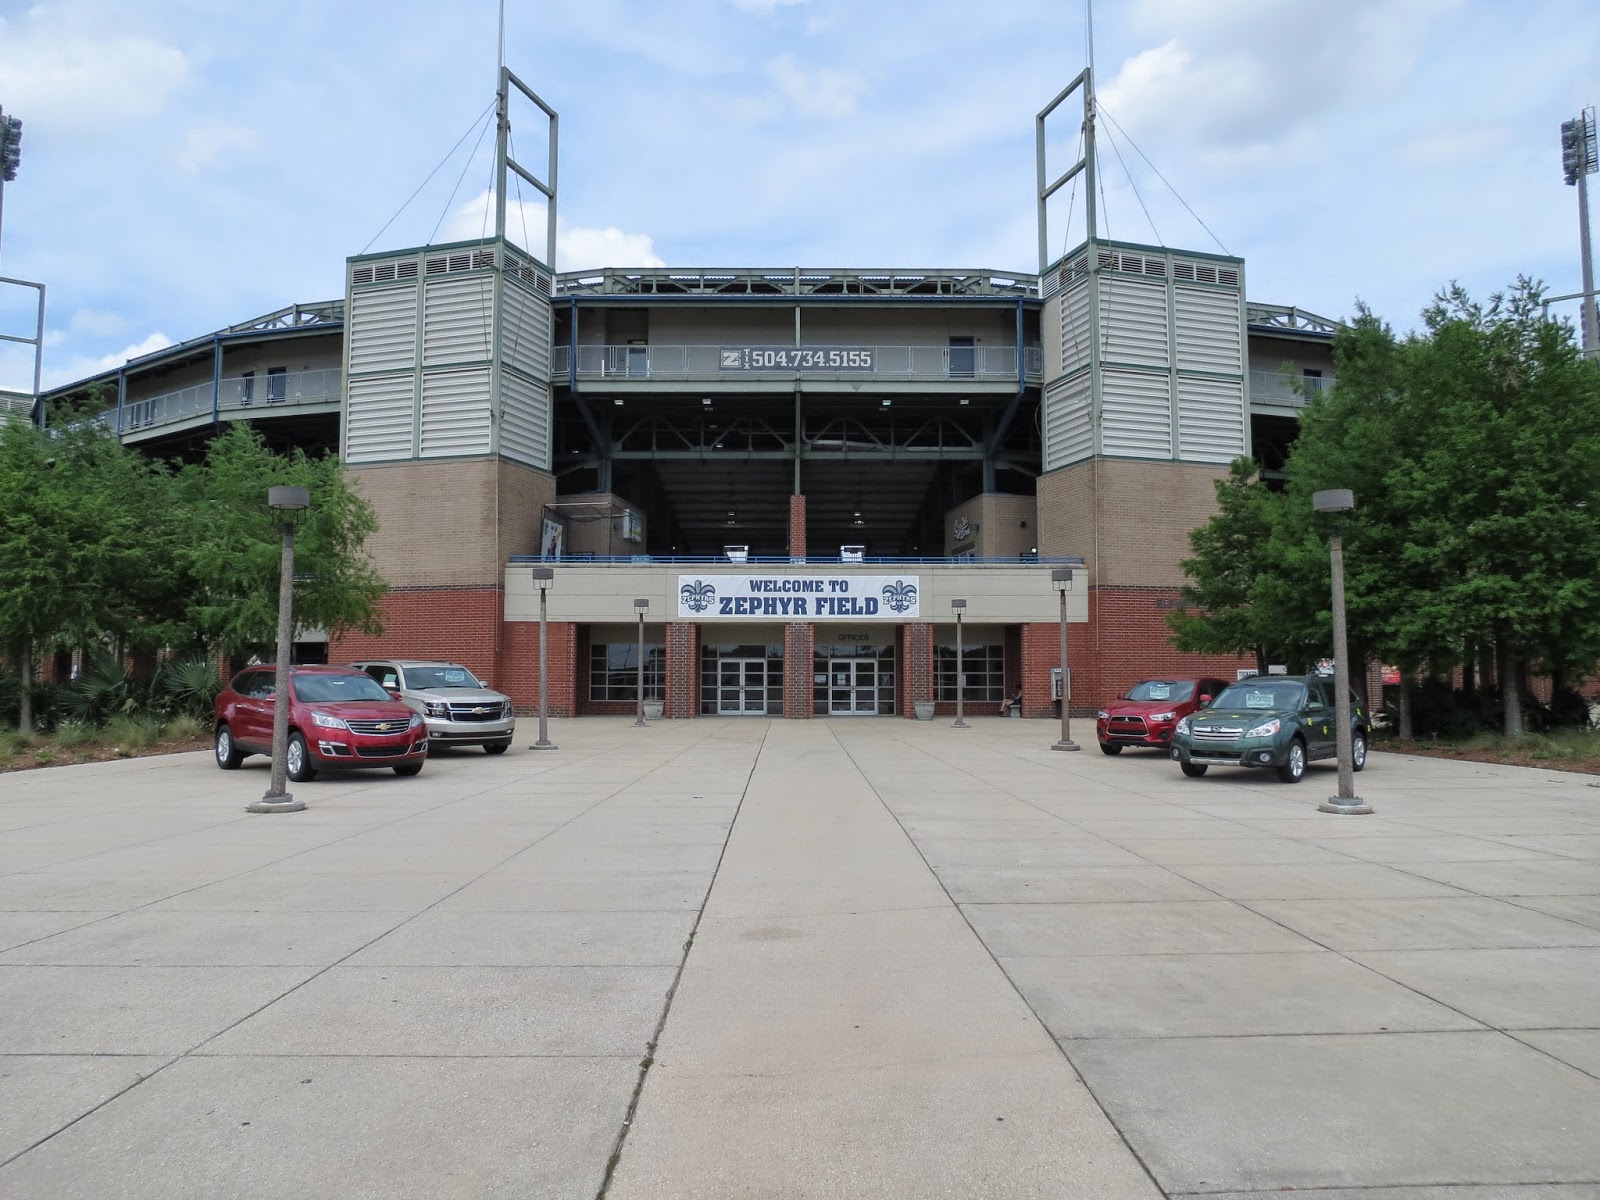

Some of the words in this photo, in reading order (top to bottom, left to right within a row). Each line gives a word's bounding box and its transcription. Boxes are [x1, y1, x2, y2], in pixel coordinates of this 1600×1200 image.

[743, 348, 751, 370] TIX
[752, 351, 871, 367] 504.734.5155
[749, 580, 824, 593] WELCOME
[828, 580, 849, 593] TO
[681, 594, 715, 604] ZEPHYRS
[719, 597, 807, 615] ZEPHYR
[815, 597, 879, 615] FIELD
